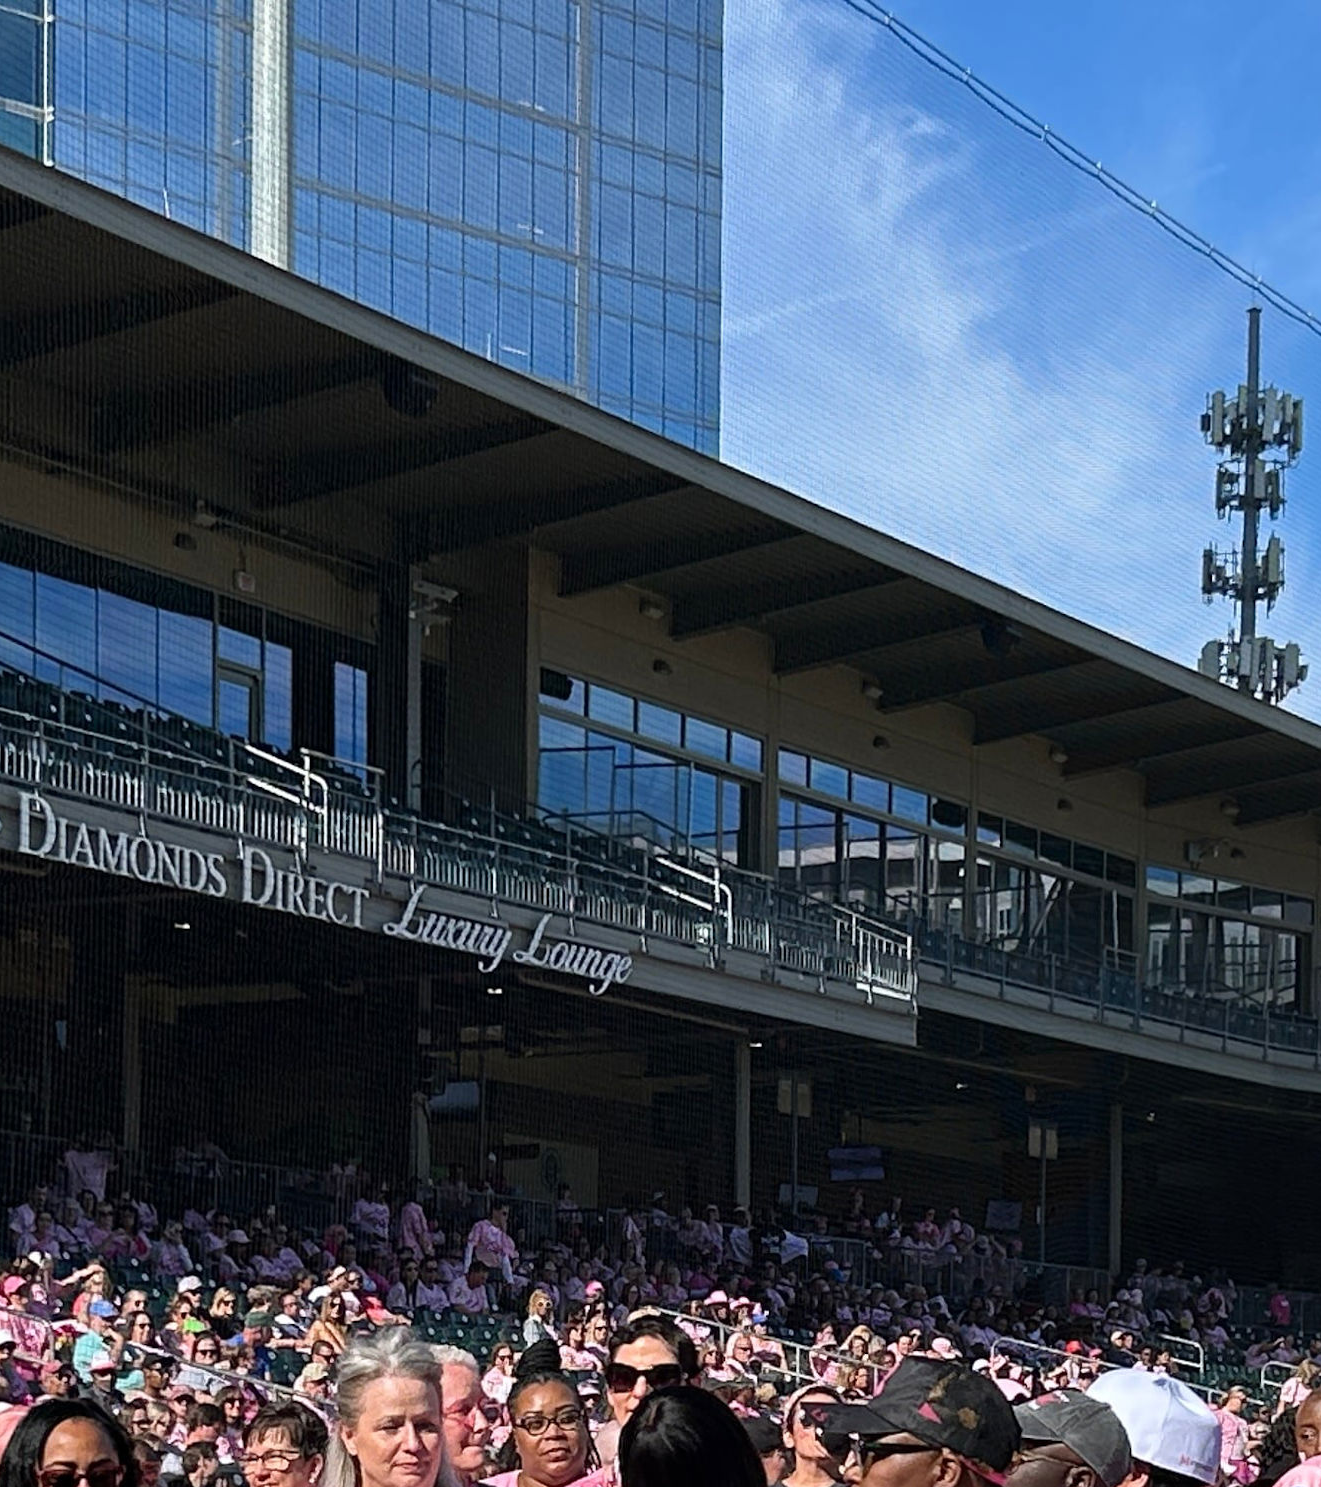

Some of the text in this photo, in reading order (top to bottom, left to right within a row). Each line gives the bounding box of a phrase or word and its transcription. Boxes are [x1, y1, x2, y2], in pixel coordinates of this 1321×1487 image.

[17, 792, 633, 995] DIAMONDS DIRECT Luxury Lounge
